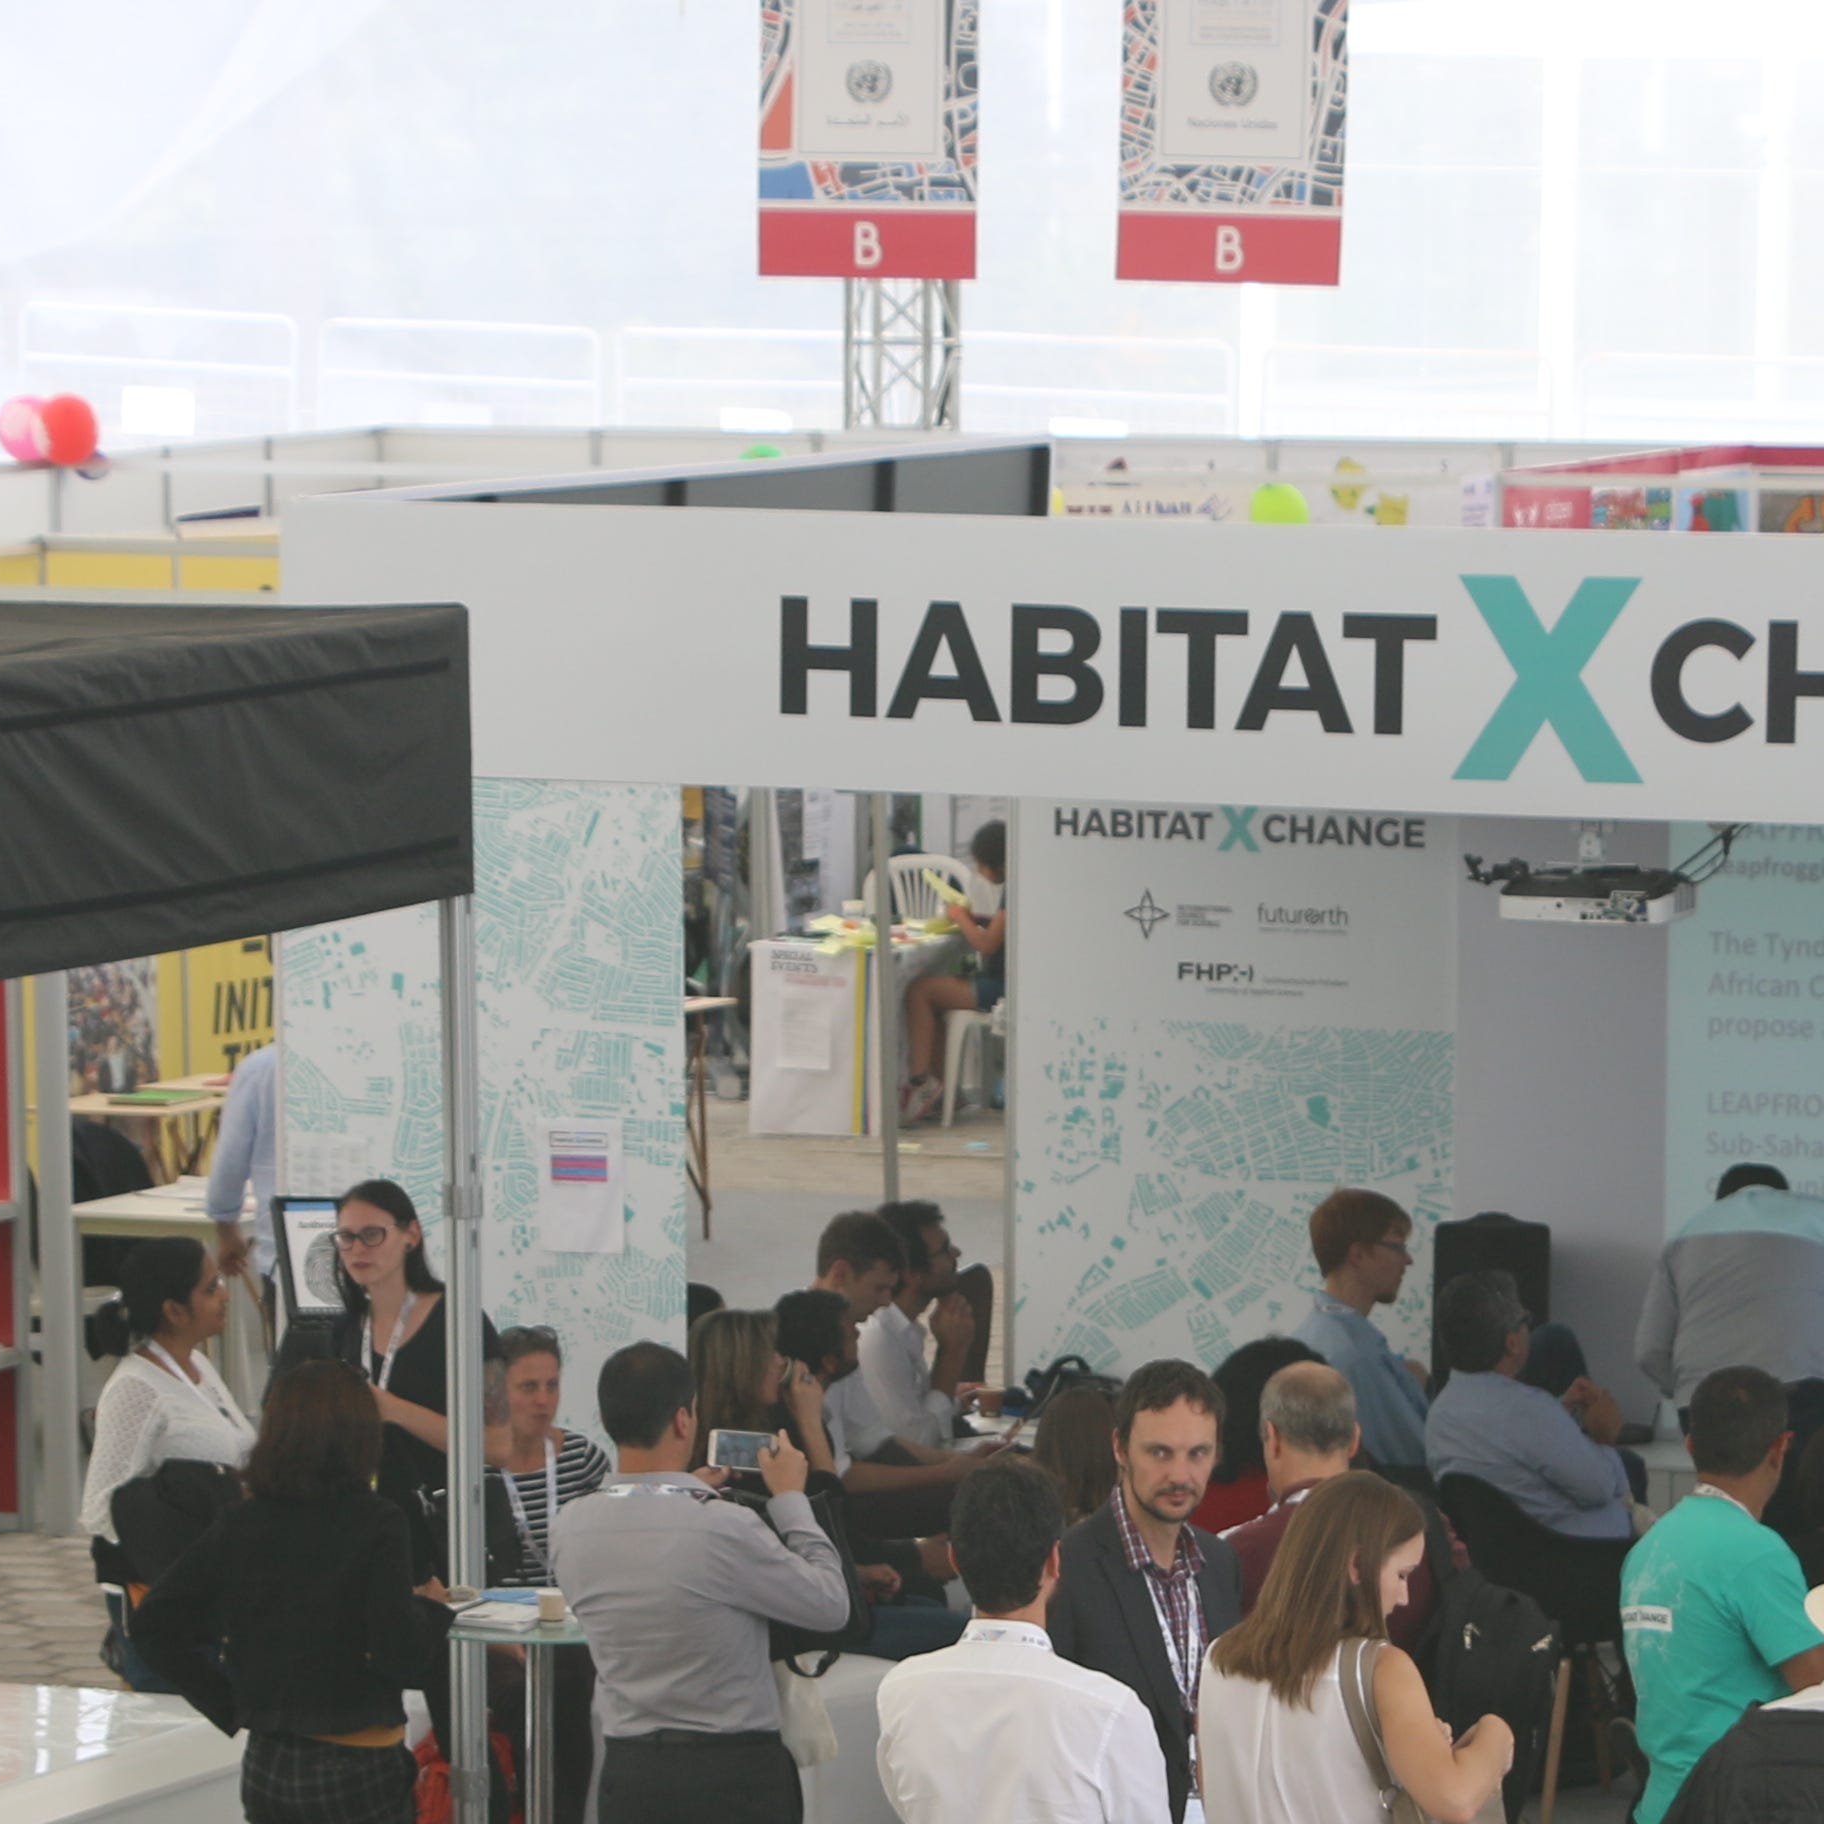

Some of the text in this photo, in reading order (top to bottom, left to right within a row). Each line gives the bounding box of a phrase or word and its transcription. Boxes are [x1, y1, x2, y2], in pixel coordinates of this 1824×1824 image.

[854, 220, 882, 269] B
[1215, 225, 1244, 274] B
[779, 594, 1437, 735] HABITAT
[1452, 573, 1645, 785] X
[1054, 804, 1427, 853] HABITAT X CHANGE
[1710, 931, 1758, 957] The
[1707, 972, 1800, 999] African
[1707, 1016, 1814, 1042] propose
